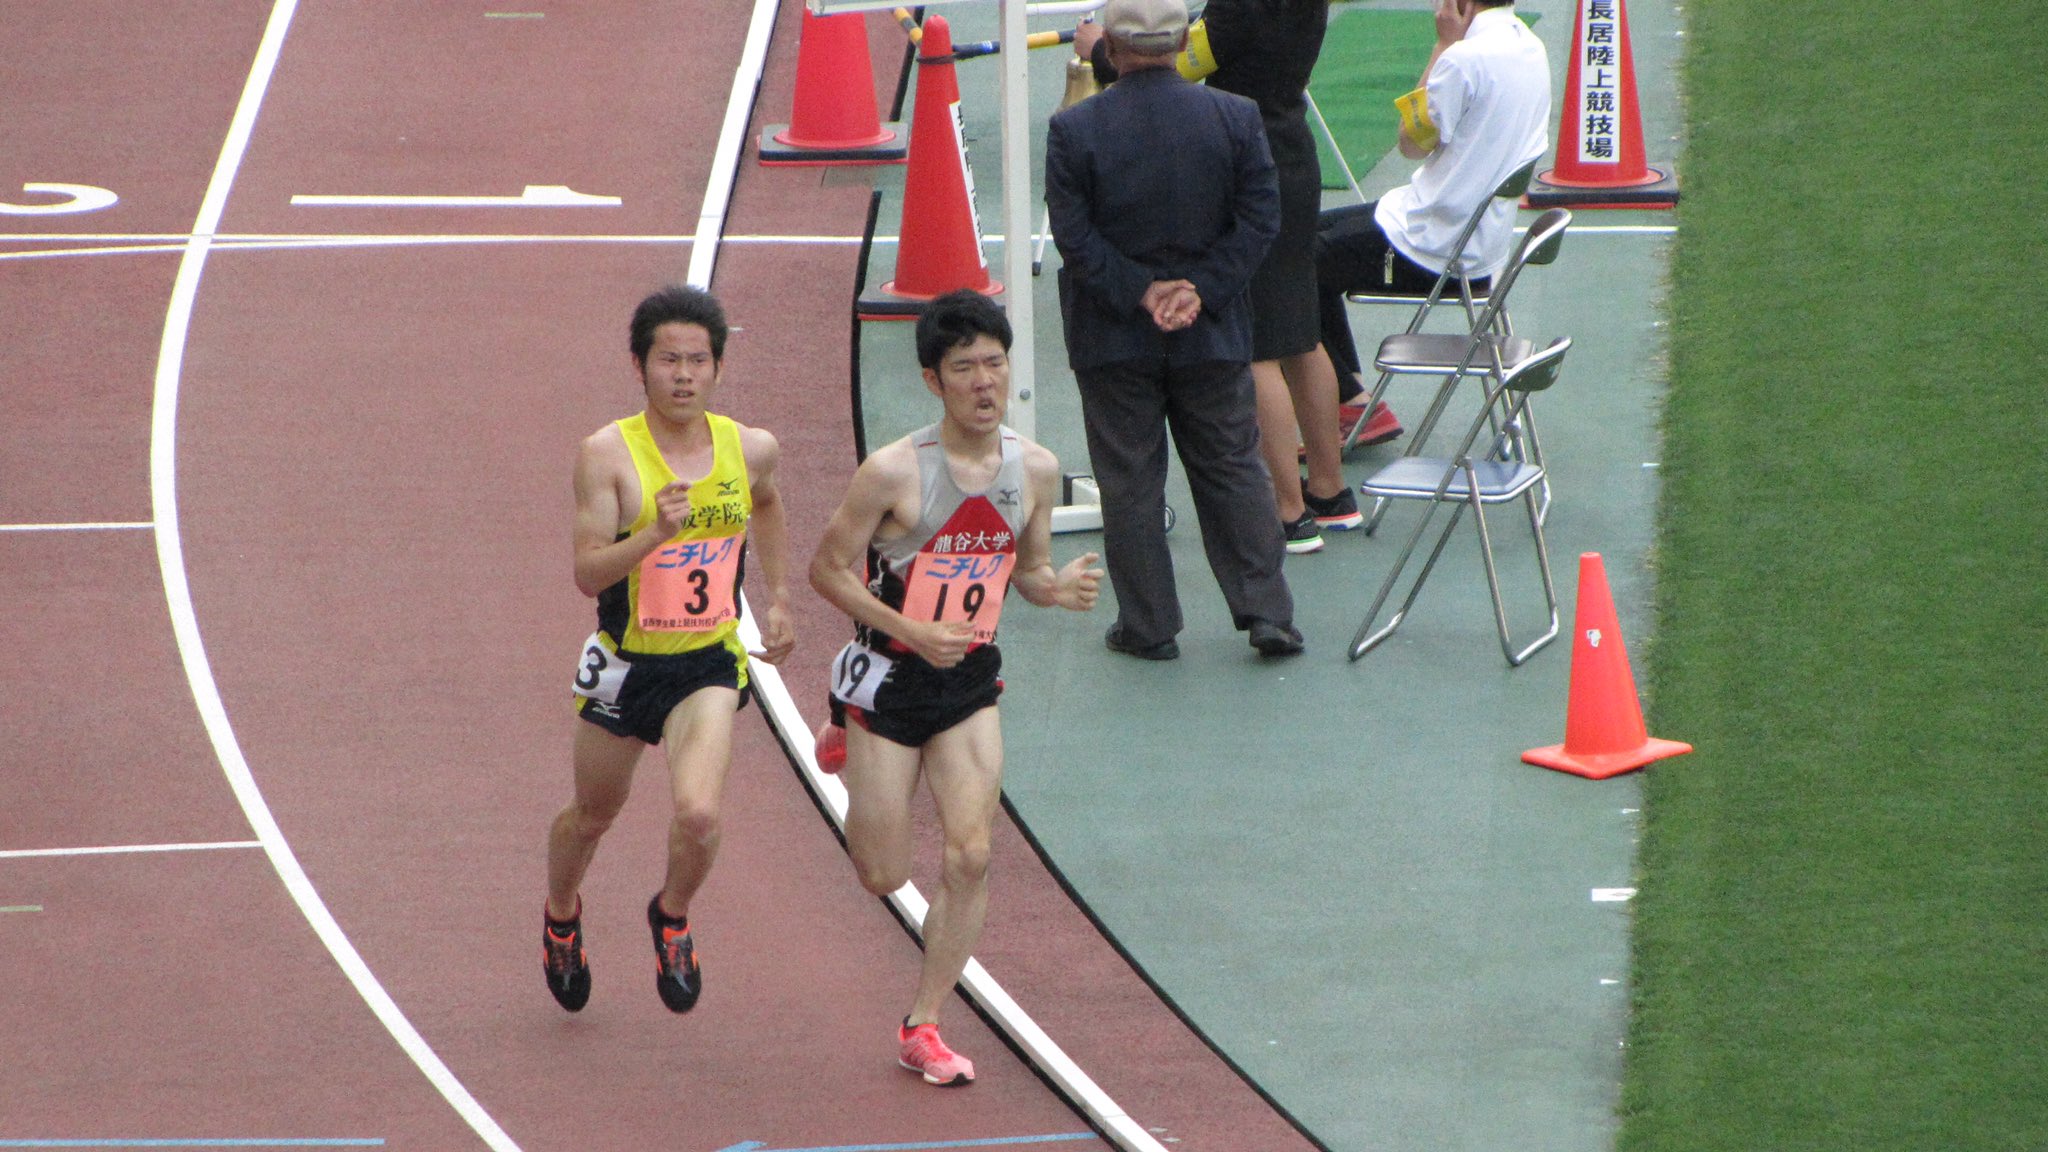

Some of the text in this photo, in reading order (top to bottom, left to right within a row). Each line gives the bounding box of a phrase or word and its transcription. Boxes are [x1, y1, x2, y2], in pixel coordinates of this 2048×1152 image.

[1586, 0, 1615, 158] 長居陸上競技場
[933, 531, 1011, 553] 龍谷大学
[685, 569, 709, 615] 3
[933, 583, 986, 622] 19
[575, 646, 607, 690] 3
[838, 645, 871, 698] 19
